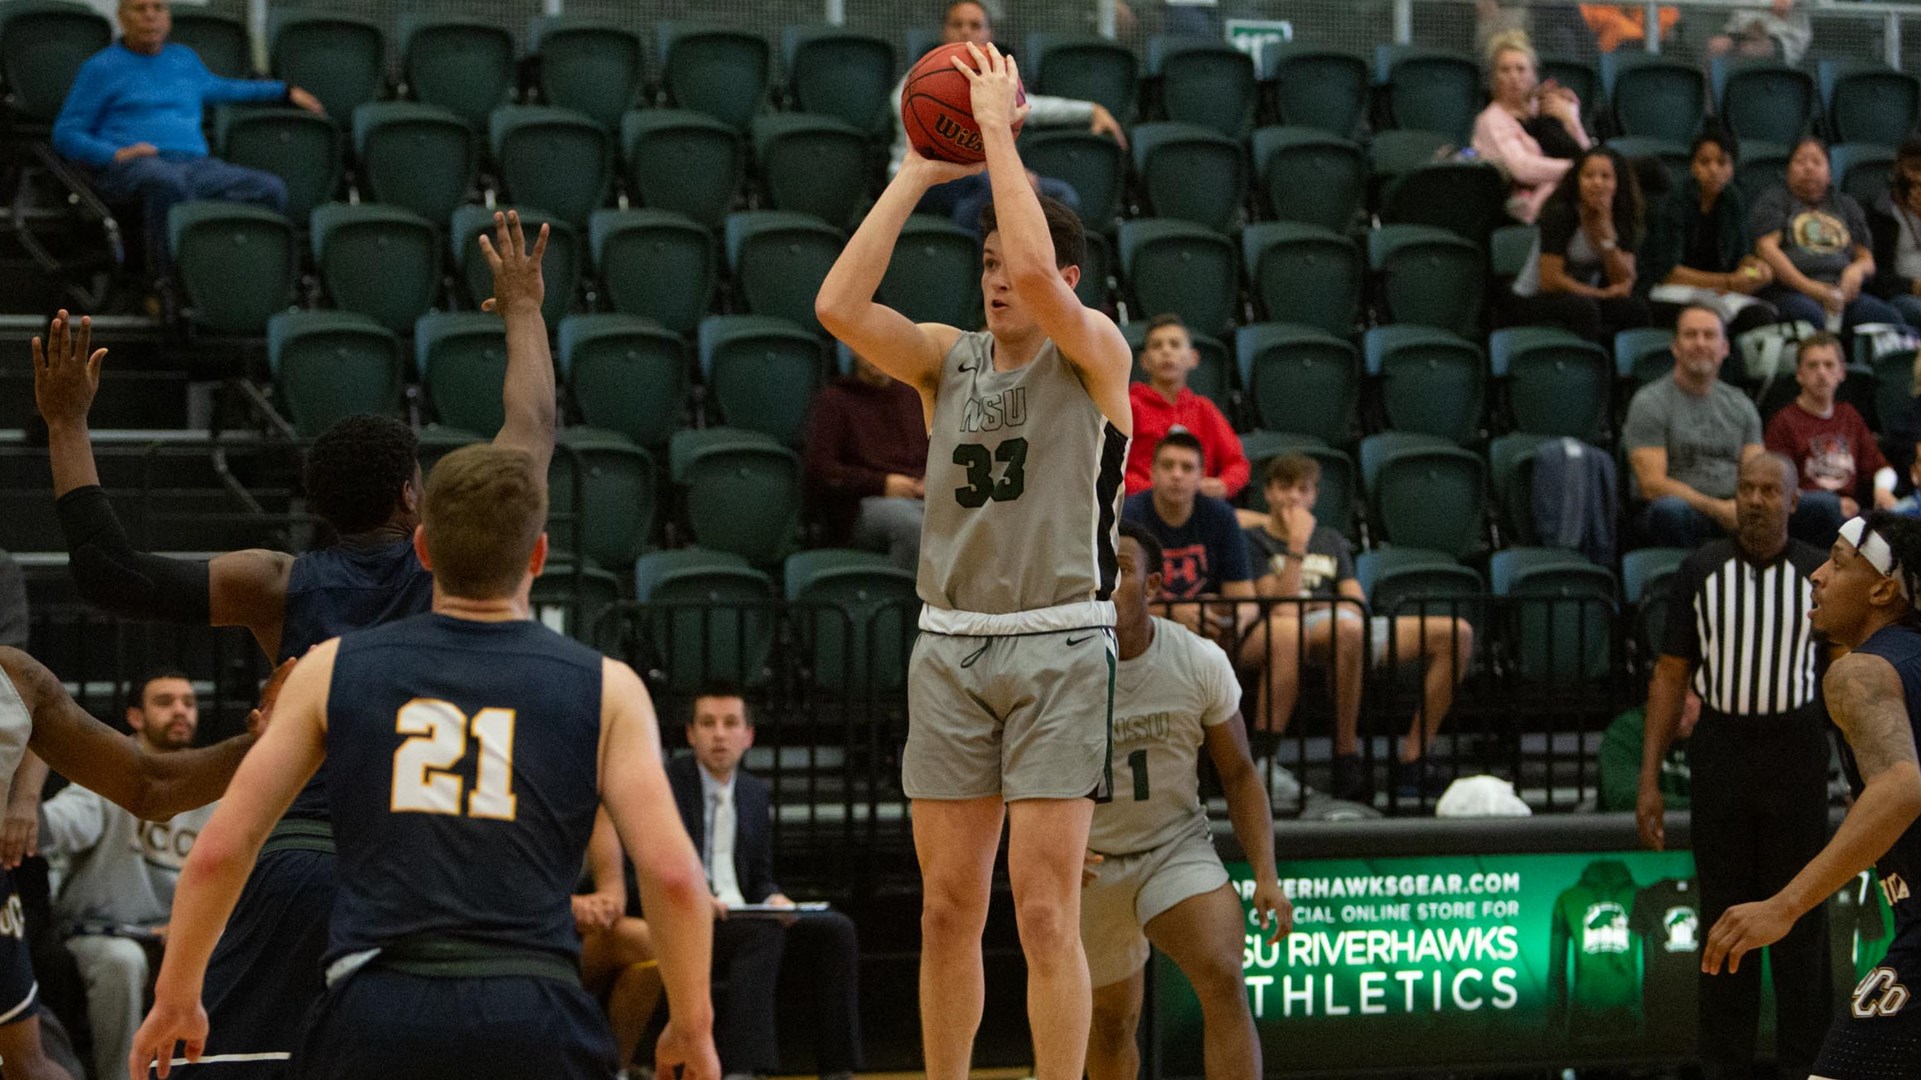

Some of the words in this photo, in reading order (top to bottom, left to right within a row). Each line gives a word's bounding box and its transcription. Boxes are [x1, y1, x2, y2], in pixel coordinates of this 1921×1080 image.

[934, 112, 985, 154] Wils
[959, 387, 1027, 432] NSU
[952, 437, 1028, 508] 33
[390, 697, 517, 822] 21
[1128, 749, 1149, 801] 1
[1232, 872, 1520, 901] RERHAWKSGEAR.COM
[1248, 905, 1336, 926] OCIAL
[1341, 903, 1411, 923] ONLINE
[1417, 901, 1476, 920] STORE
[1482, 899, 1520, 917] FOR
[1242, 933, 1280, 969] SU
[1287, 925, 1519, 968] RIVERHAWKS
[1244, 966, 1518, 1018] THLETICS
